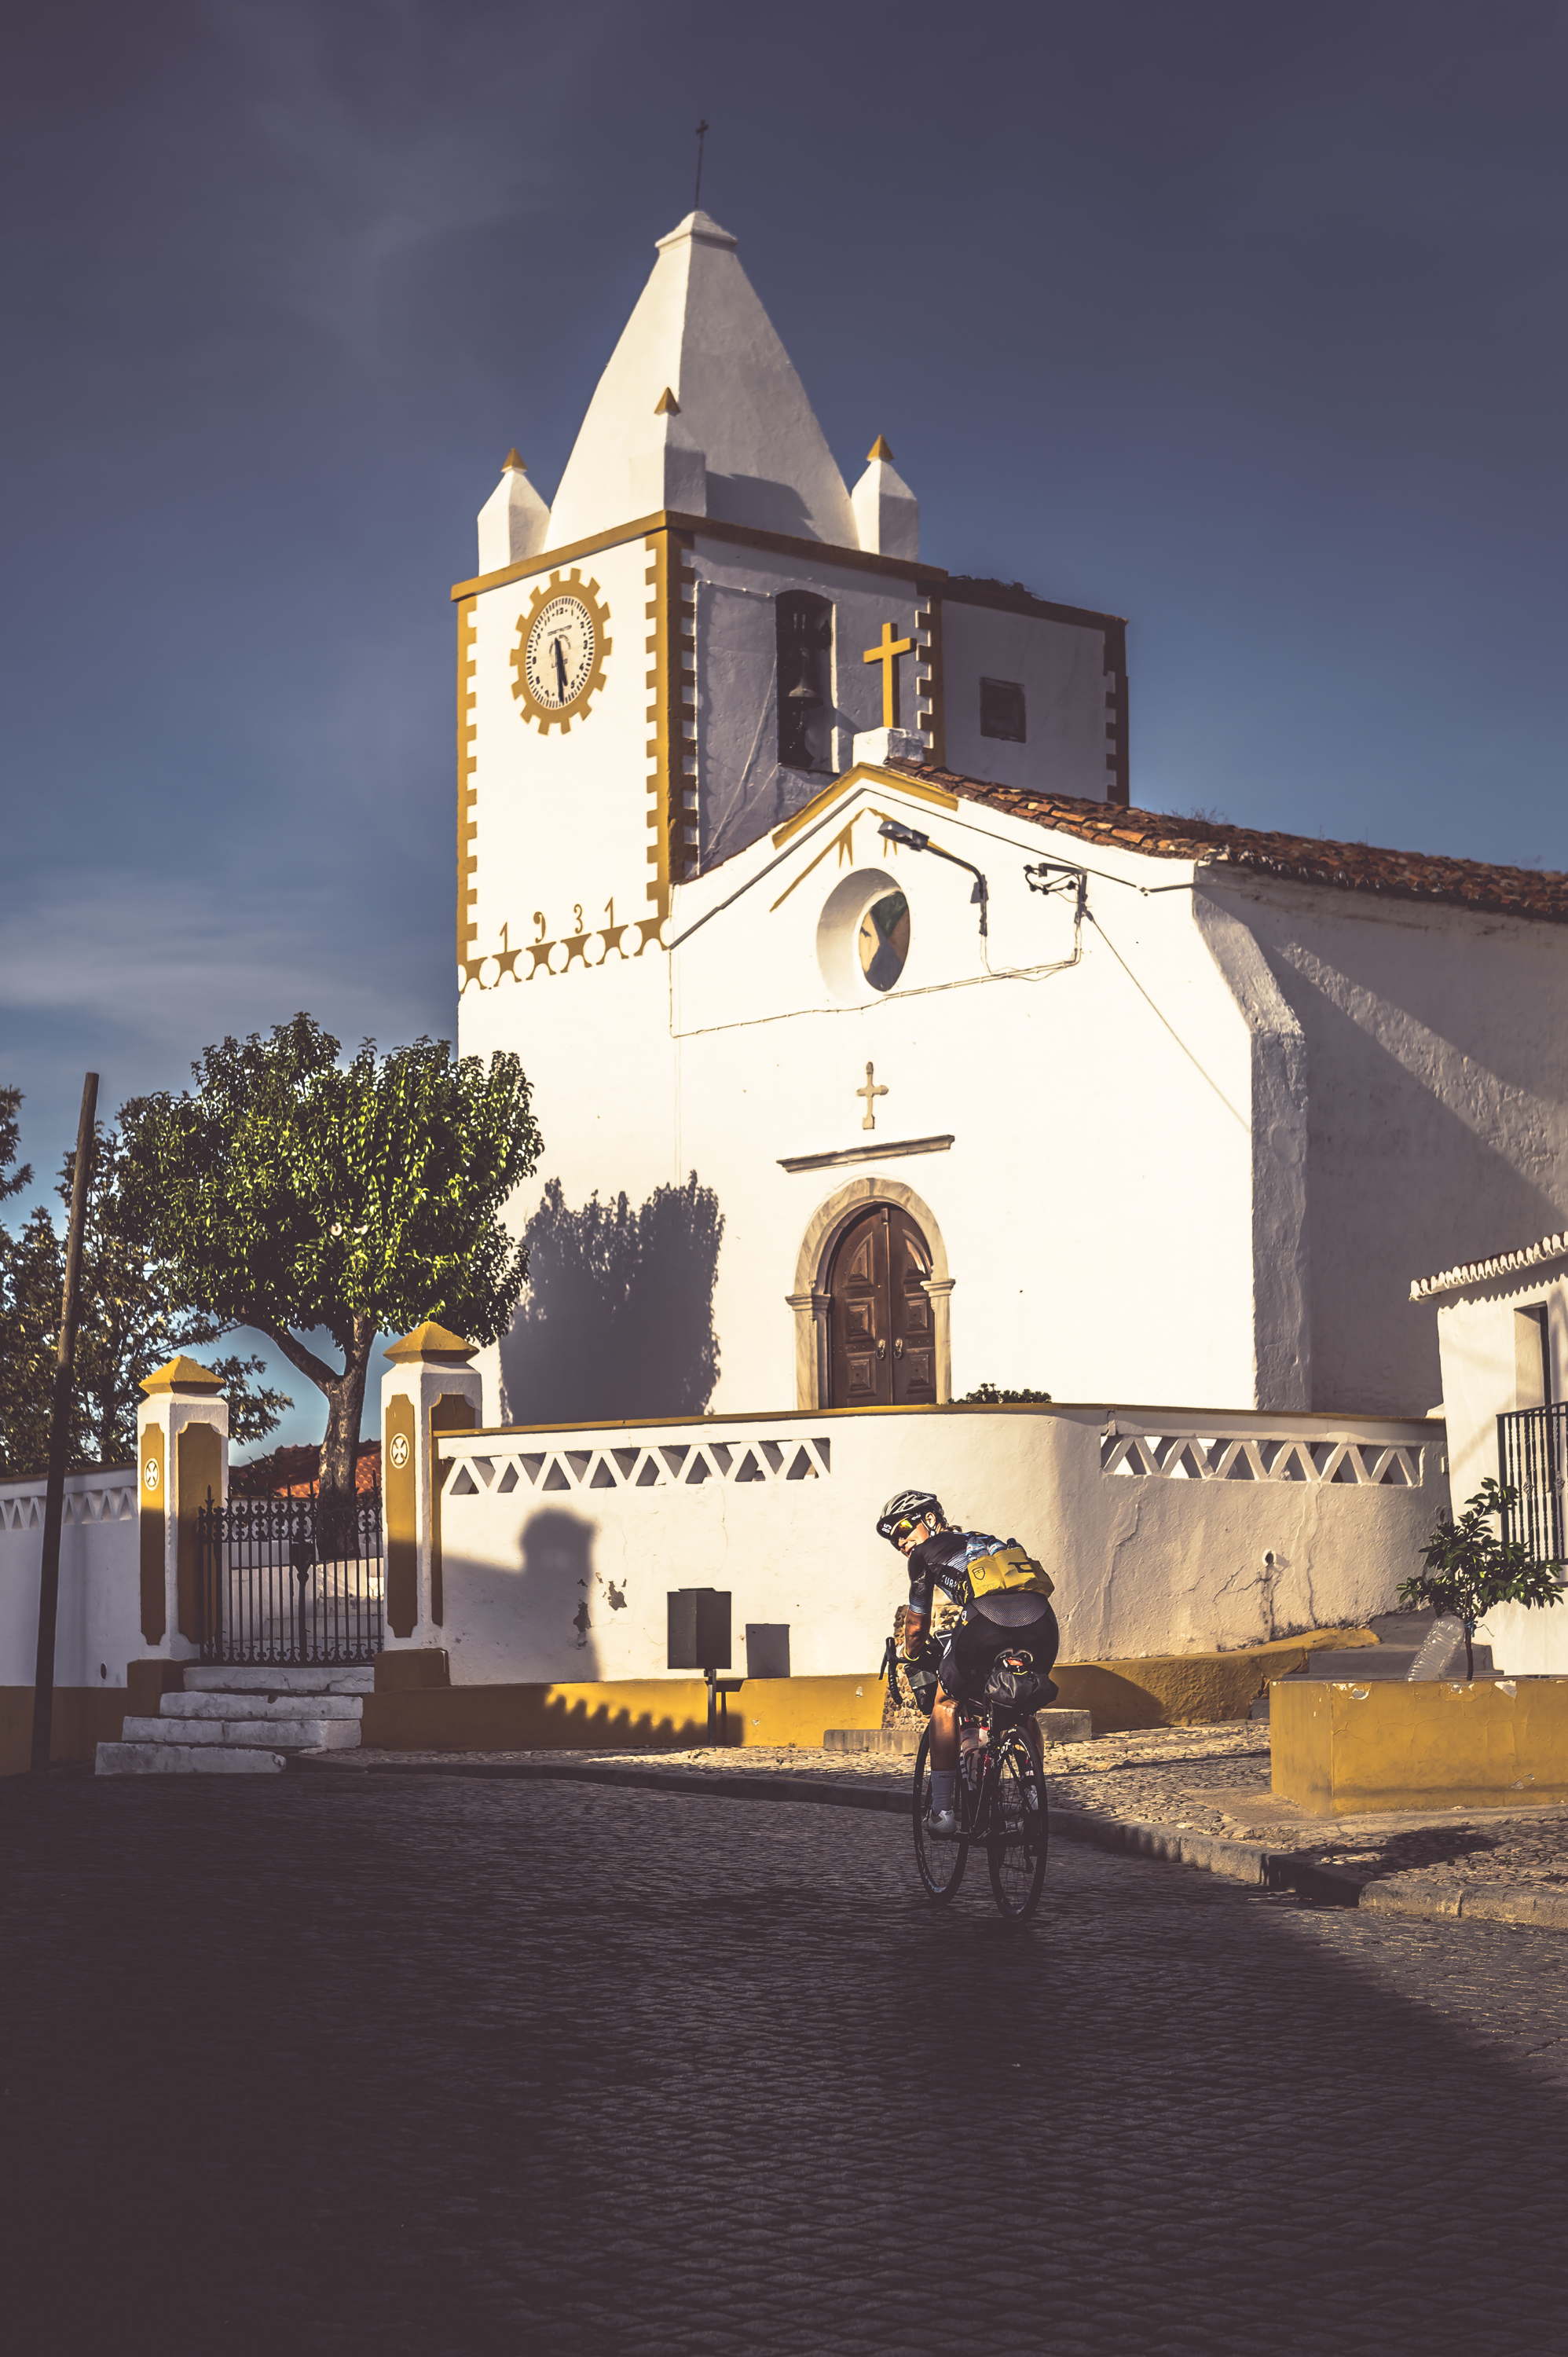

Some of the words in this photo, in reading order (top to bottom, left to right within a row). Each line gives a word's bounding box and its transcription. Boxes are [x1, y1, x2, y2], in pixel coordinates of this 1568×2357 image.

[583, 640, 588, 650] 3
[570, 680, 575, 689] 5
[499, 896, 614, 953] 1931
[881, 1523, 892, 1534] 85
